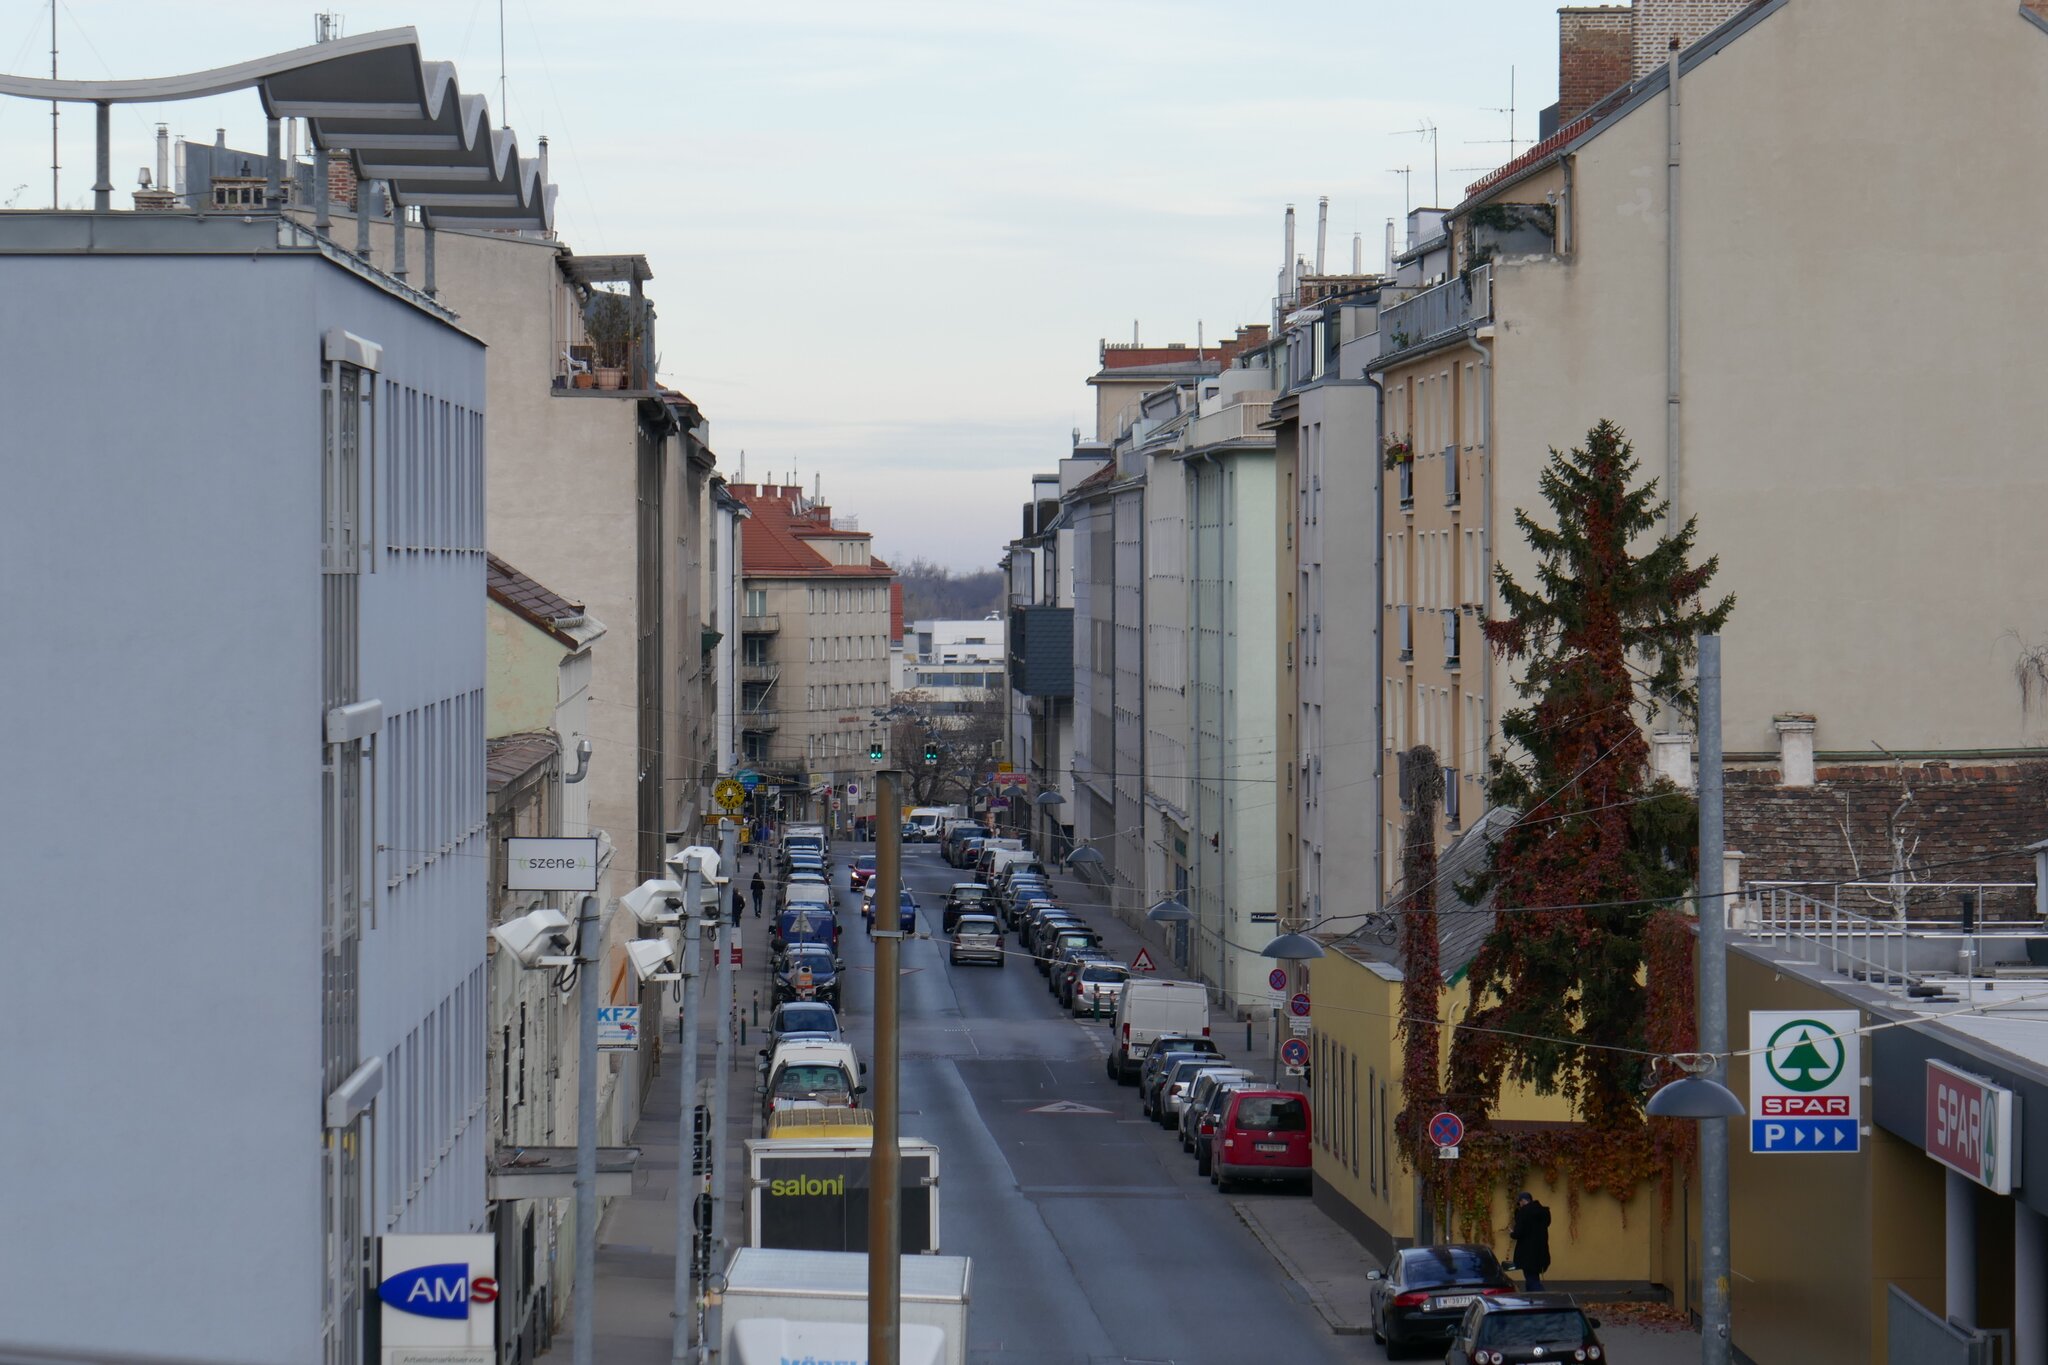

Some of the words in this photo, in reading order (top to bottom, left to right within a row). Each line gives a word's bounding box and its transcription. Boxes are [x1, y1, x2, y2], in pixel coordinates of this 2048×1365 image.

[529, 858, 575, 869] szene
[1765, 1098, 1847, 1114] SPAR
[1938, 1083, 1980, 1164] SPAR
[1765, 1124, 1786, 1149] P
[407, 1277, 499, 1304] AMS
